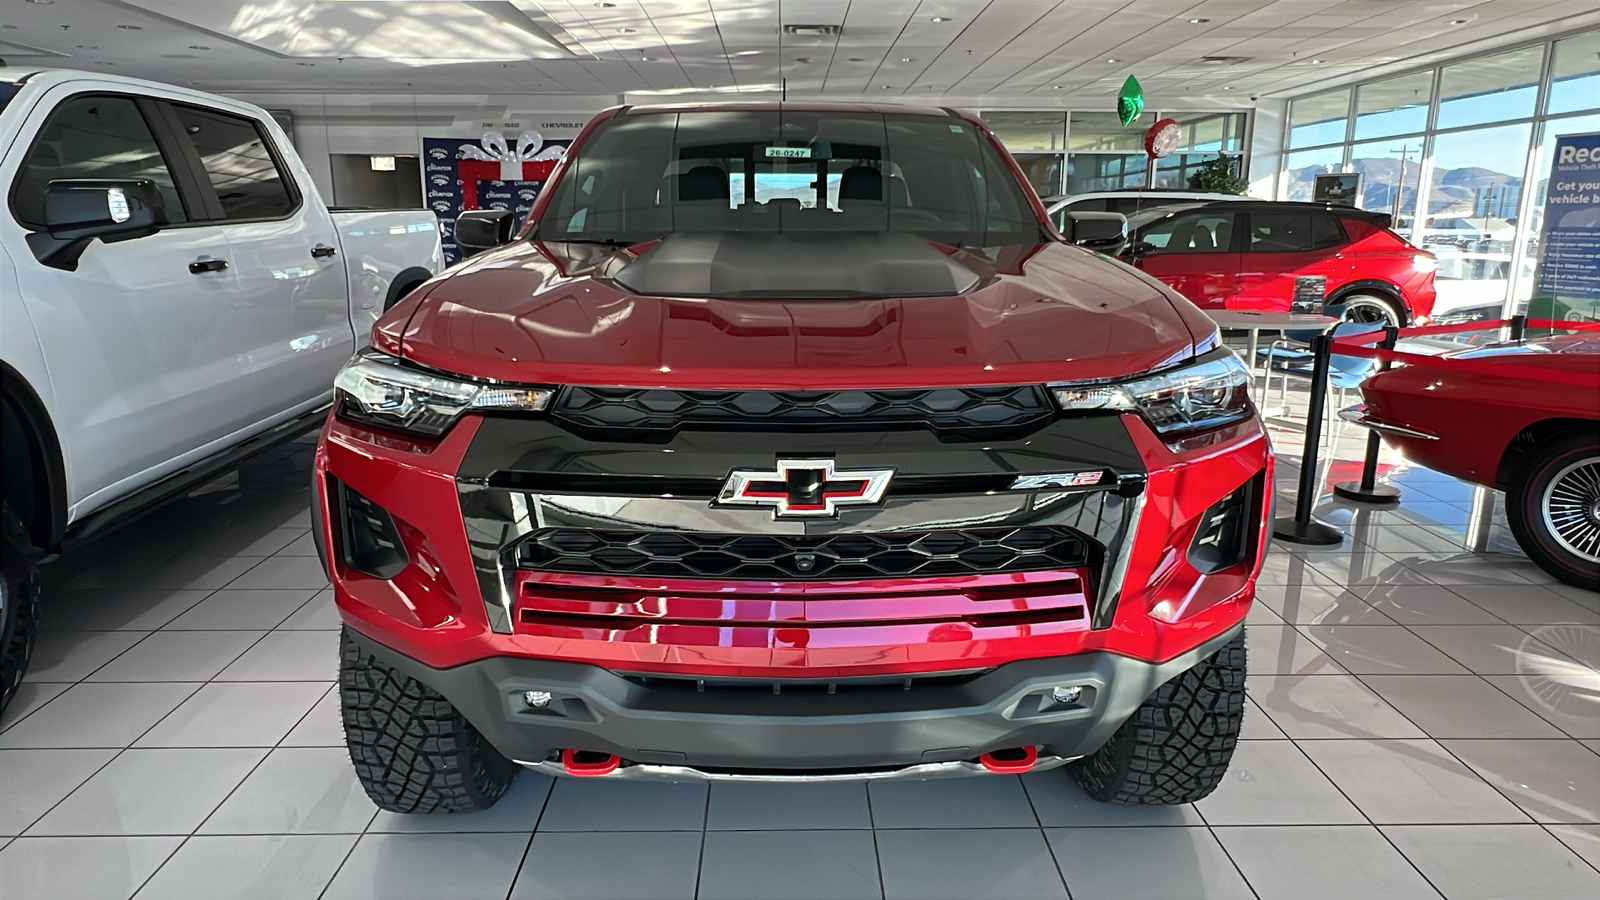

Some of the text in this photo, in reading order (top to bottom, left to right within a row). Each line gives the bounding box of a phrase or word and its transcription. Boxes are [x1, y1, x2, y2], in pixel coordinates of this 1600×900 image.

[770, 149, 806, 157] 26-0247
[1556, 181, 1577, 191] Get
[1550, 194, 1590, 204] vehicle
[1010, 471, 1104, 490] ZR2
